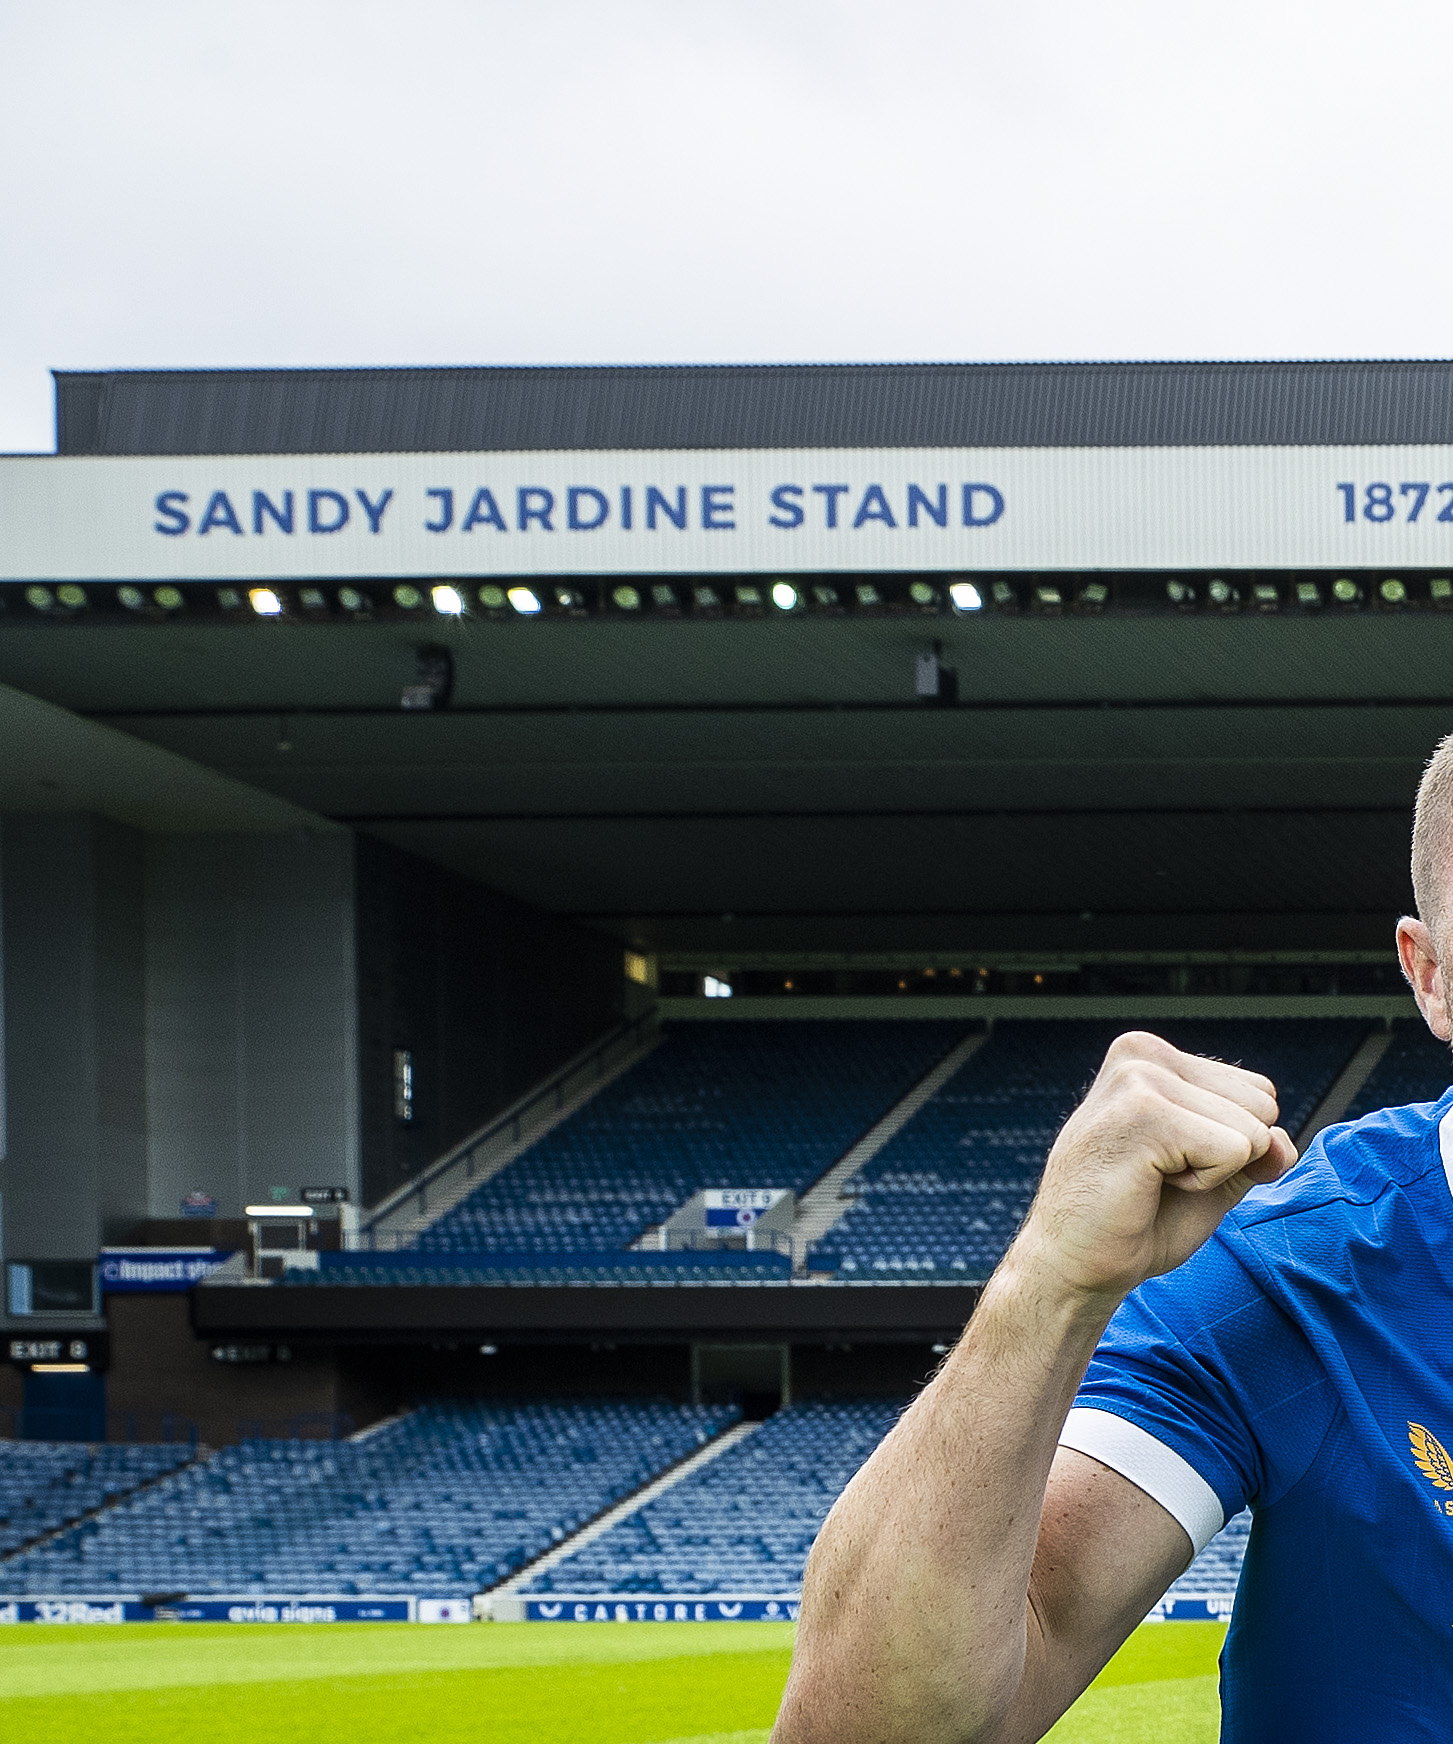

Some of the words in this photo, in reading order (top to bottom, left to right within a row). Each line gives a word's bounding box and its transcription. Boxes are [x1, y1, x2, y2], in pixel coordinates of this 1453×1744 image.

[153, 488, 393, 536] SANDY
[424, 485, 736, 533] JARDINE
[768, 482, 1005, 529] STAND
[723, 1191, 756, 1204] EXIT
[10, 1340, 62, 1359] EXIT
[33, 1602, 124, 1622] 32Red
[574, 1603, 707, 1621] CASTORE
